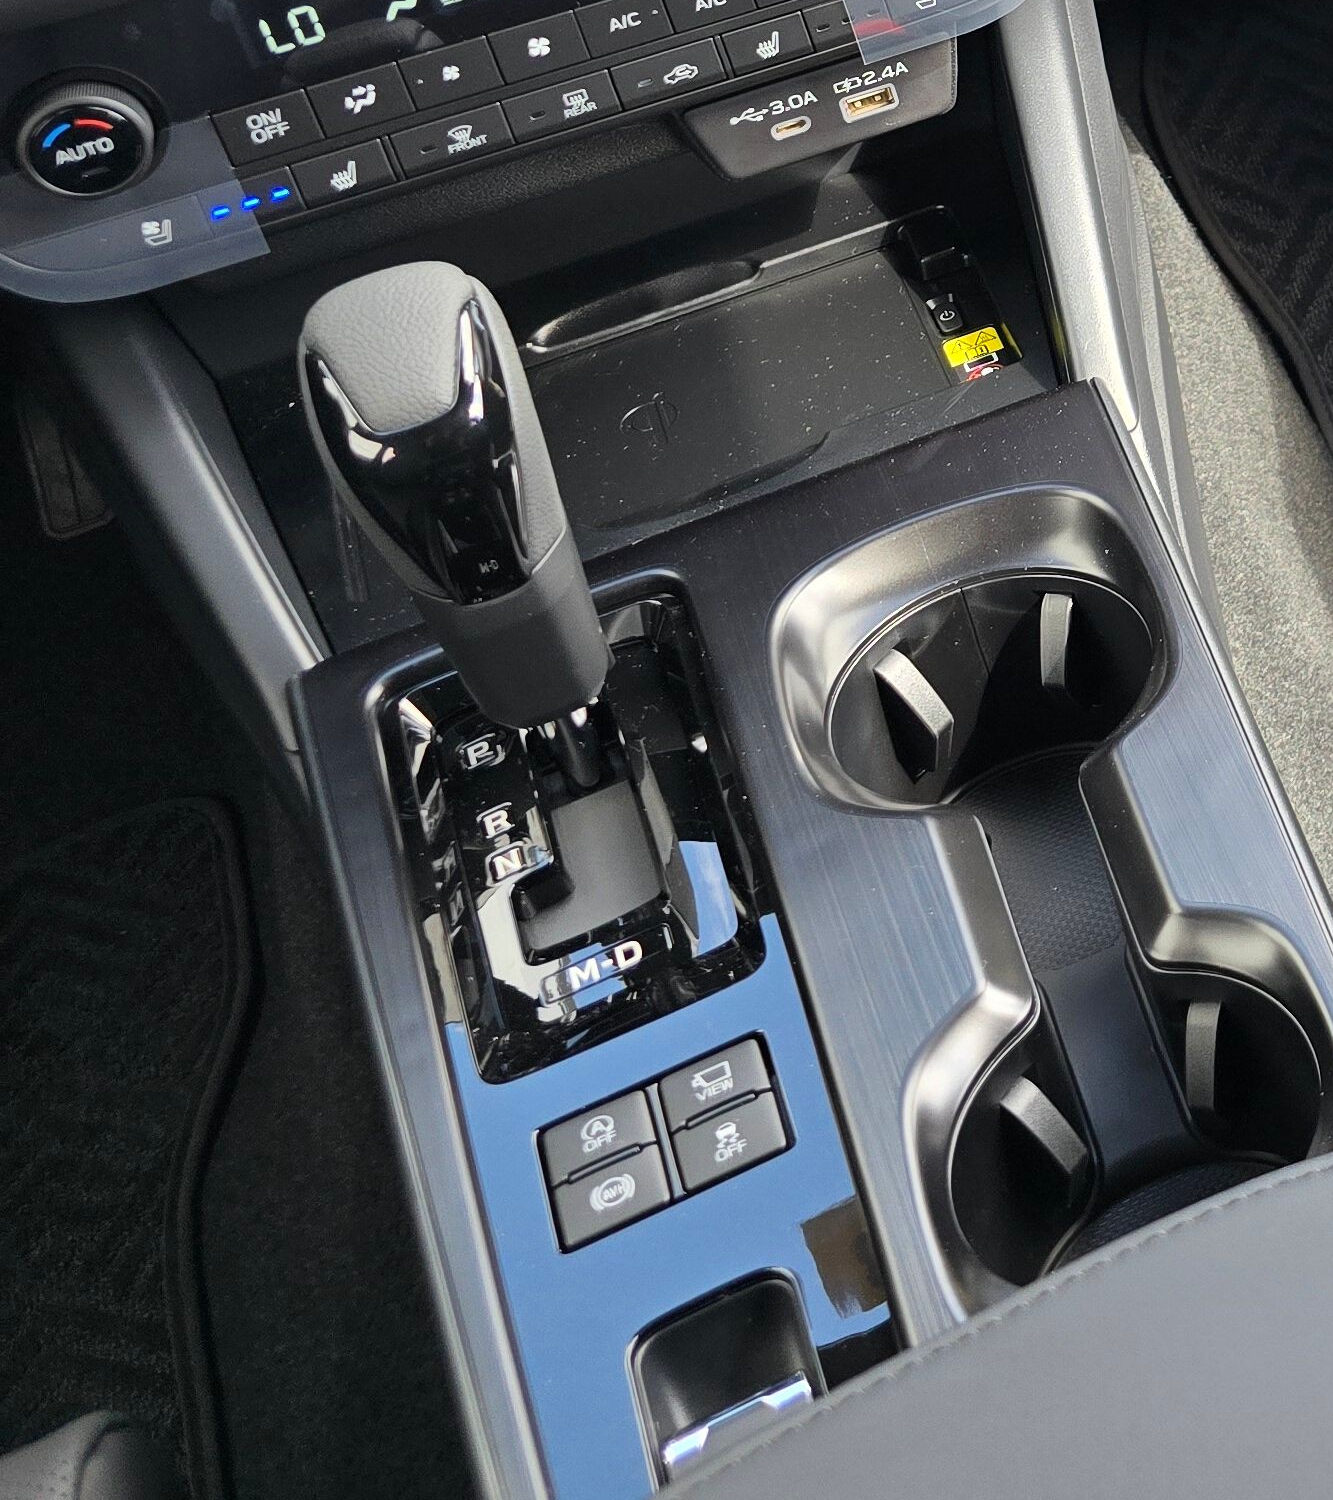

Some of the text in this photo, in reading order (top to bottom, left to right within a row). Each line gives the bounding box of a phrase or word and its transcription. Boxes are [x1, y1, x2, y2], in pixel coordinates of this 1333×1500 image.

[609, 11, 642, 34] A/C
[862, 61, 909, 86] 2.4A
[563, 101, 598, 120] REAR
[768, 90, 818, 115] 3.0A
[246, 108, 282, 130] ON/
[250, 120, 290, 145] OFF
[447, 133, 488, 156] FRONT
[56, 137, 115, 166] AUTO
[467, 741, 491, 767] P
[481, 809, 515, 839] R
[492, 847, 523, 880] N
[695, 1077, 734, 1101] VIEW
[582, 1129, 617, 1153] OFF
[714, 1137, 748, 1163] OFF
